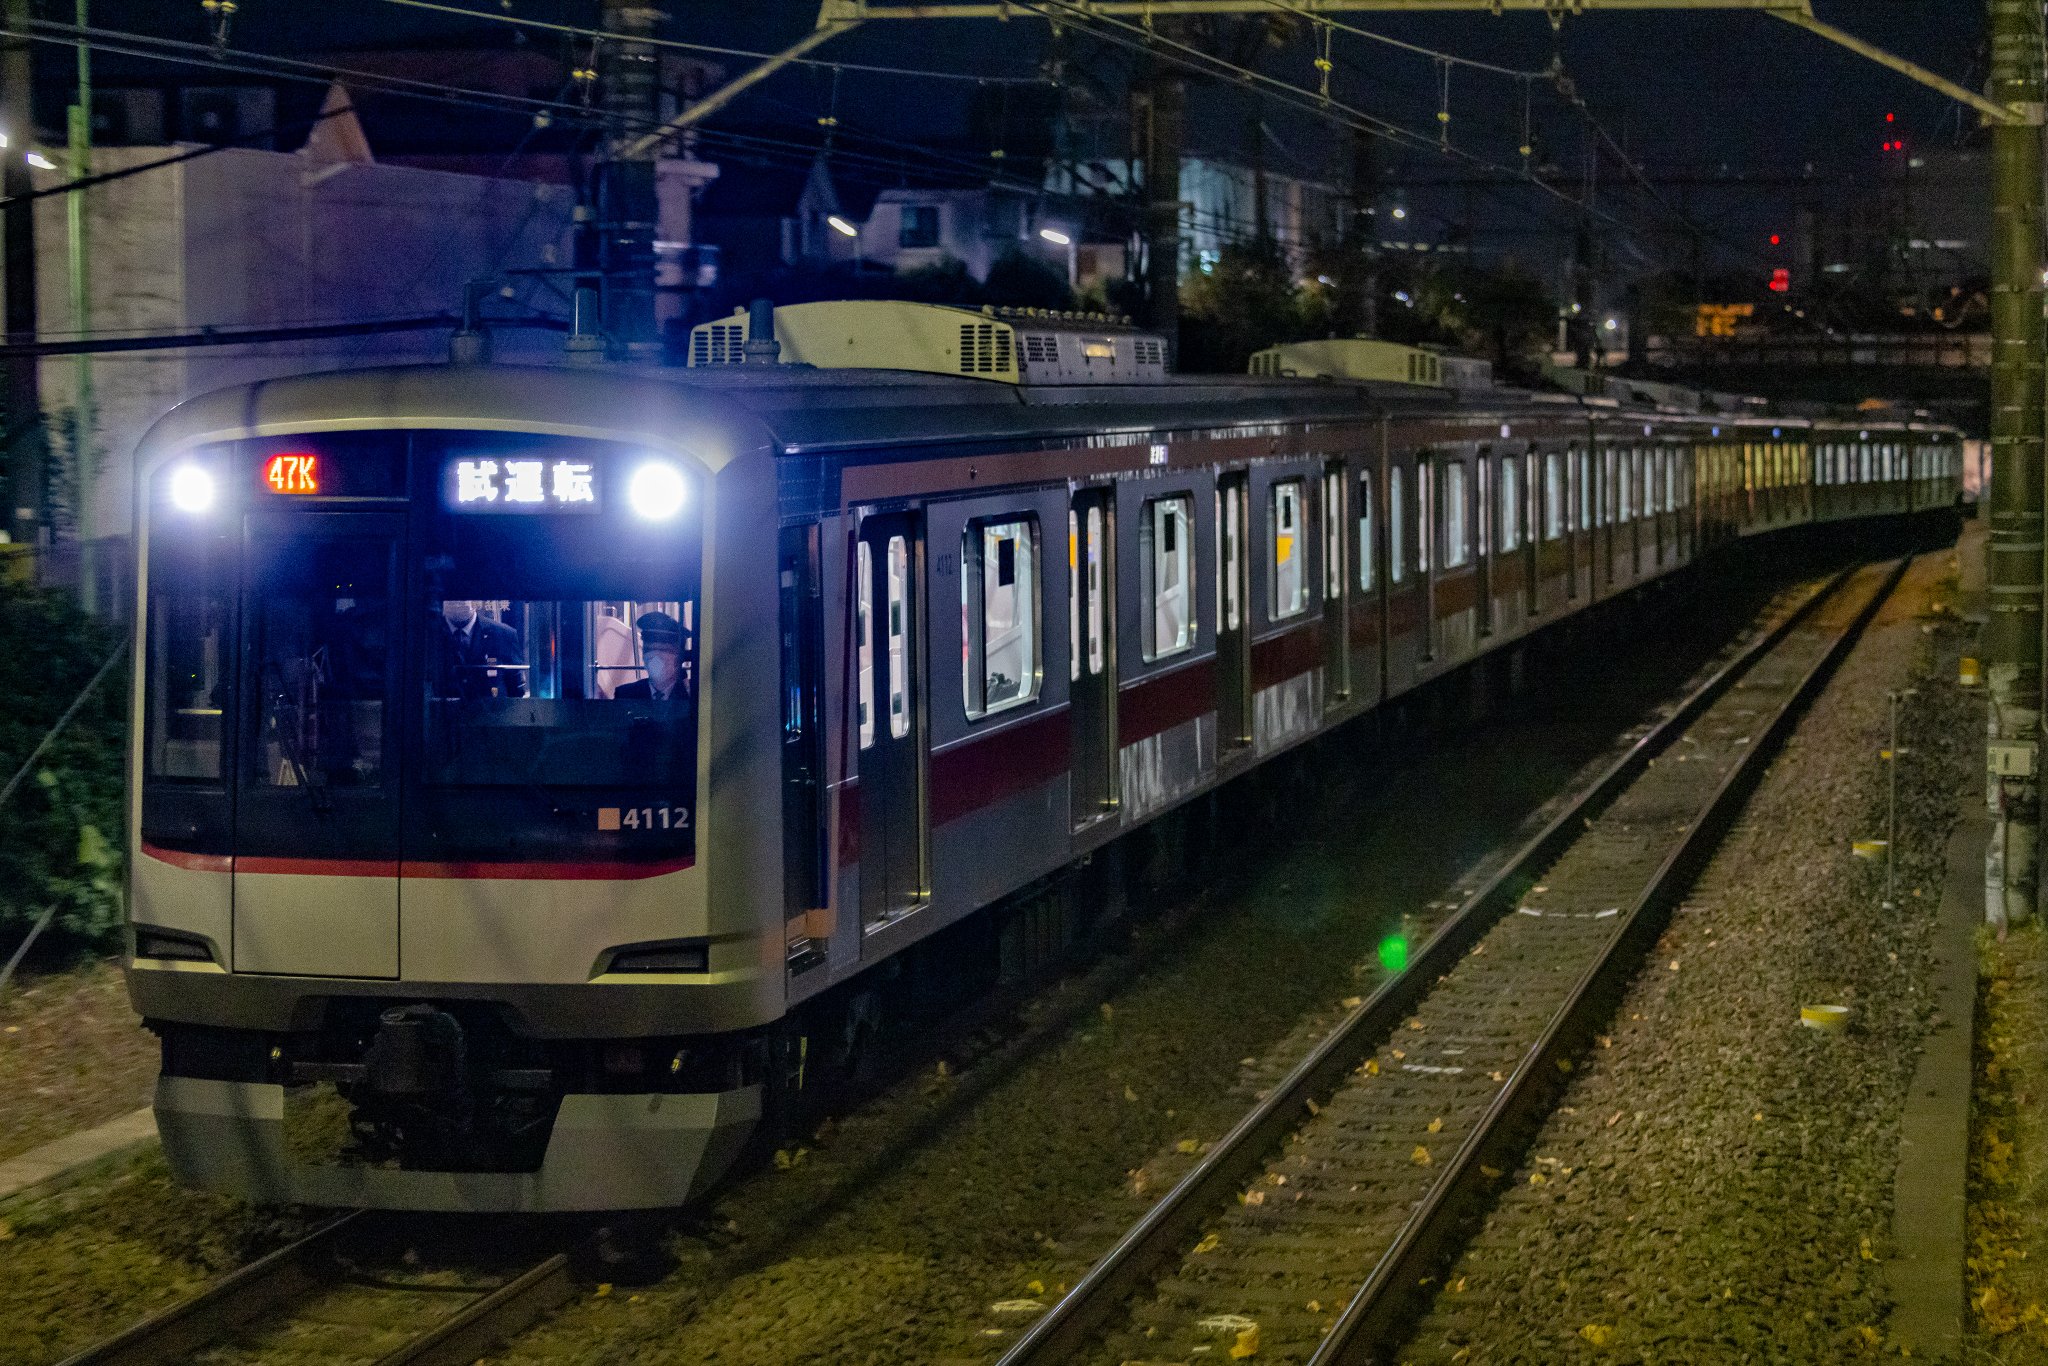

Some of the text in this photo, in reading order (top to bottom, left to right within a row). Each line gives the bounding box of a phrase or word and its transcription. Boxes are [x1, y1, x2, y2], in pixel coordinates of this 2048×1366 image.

[269, 456, 315, 490] 47K
[457, 460, 594, 503] 試運転
[623, 808, 689, 830] 4112
